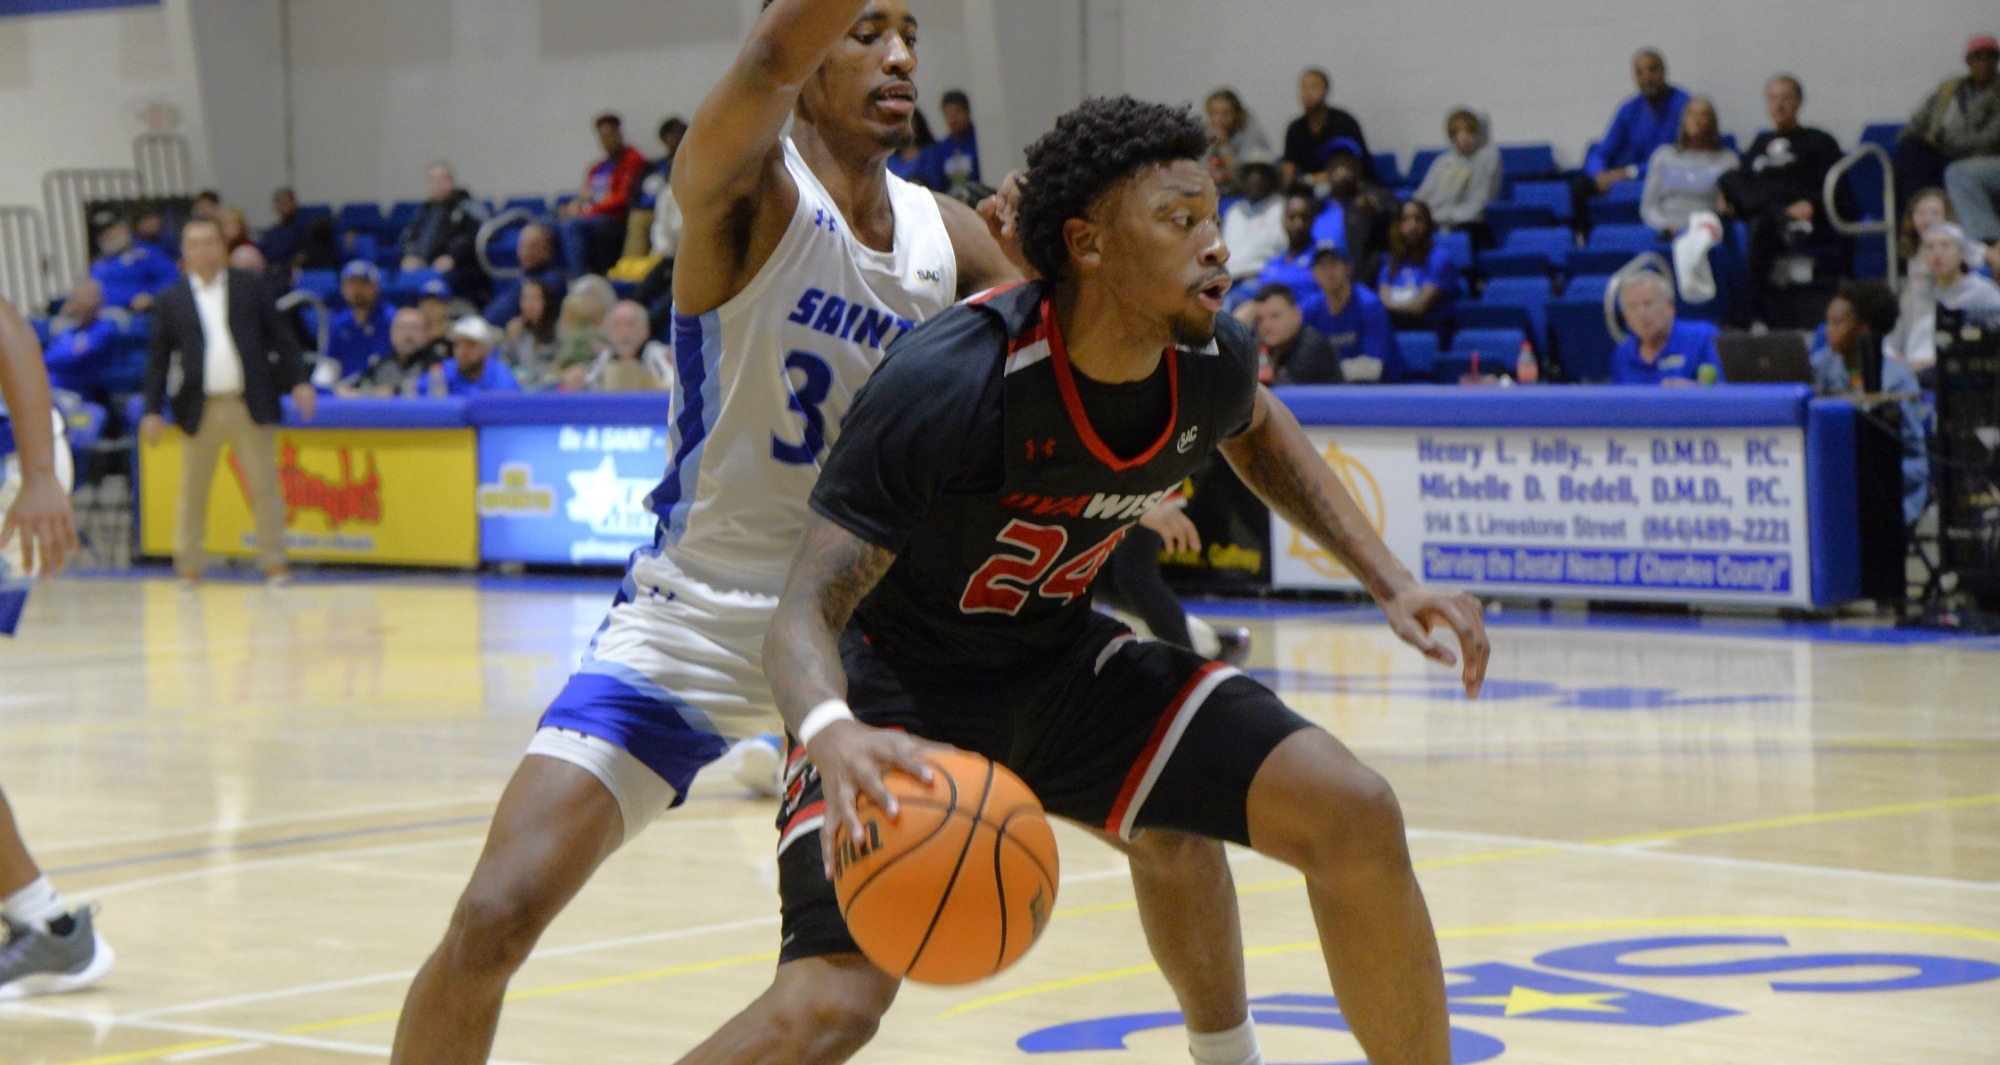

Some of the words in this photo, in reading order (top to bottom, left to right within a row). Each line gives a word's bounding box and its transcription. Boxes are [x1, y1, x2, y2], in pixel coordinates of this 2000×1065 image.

[917, 270, 940, 283] SAC
[769, 351, 834, 466] 3
[1179, 425, 1199, 449] SAC
[1418, 437, 1483, 470] Henry
[1497, 437, 1517, 464] L.
[1746, 437, 1789, 467] P.C.
[1419, 472, 1511, 502] Michelle
[1524, 473, 1546, 502] D.
[1746, 476, 1791, 507] P.C.
[959, 518, 1137, 617] 24
